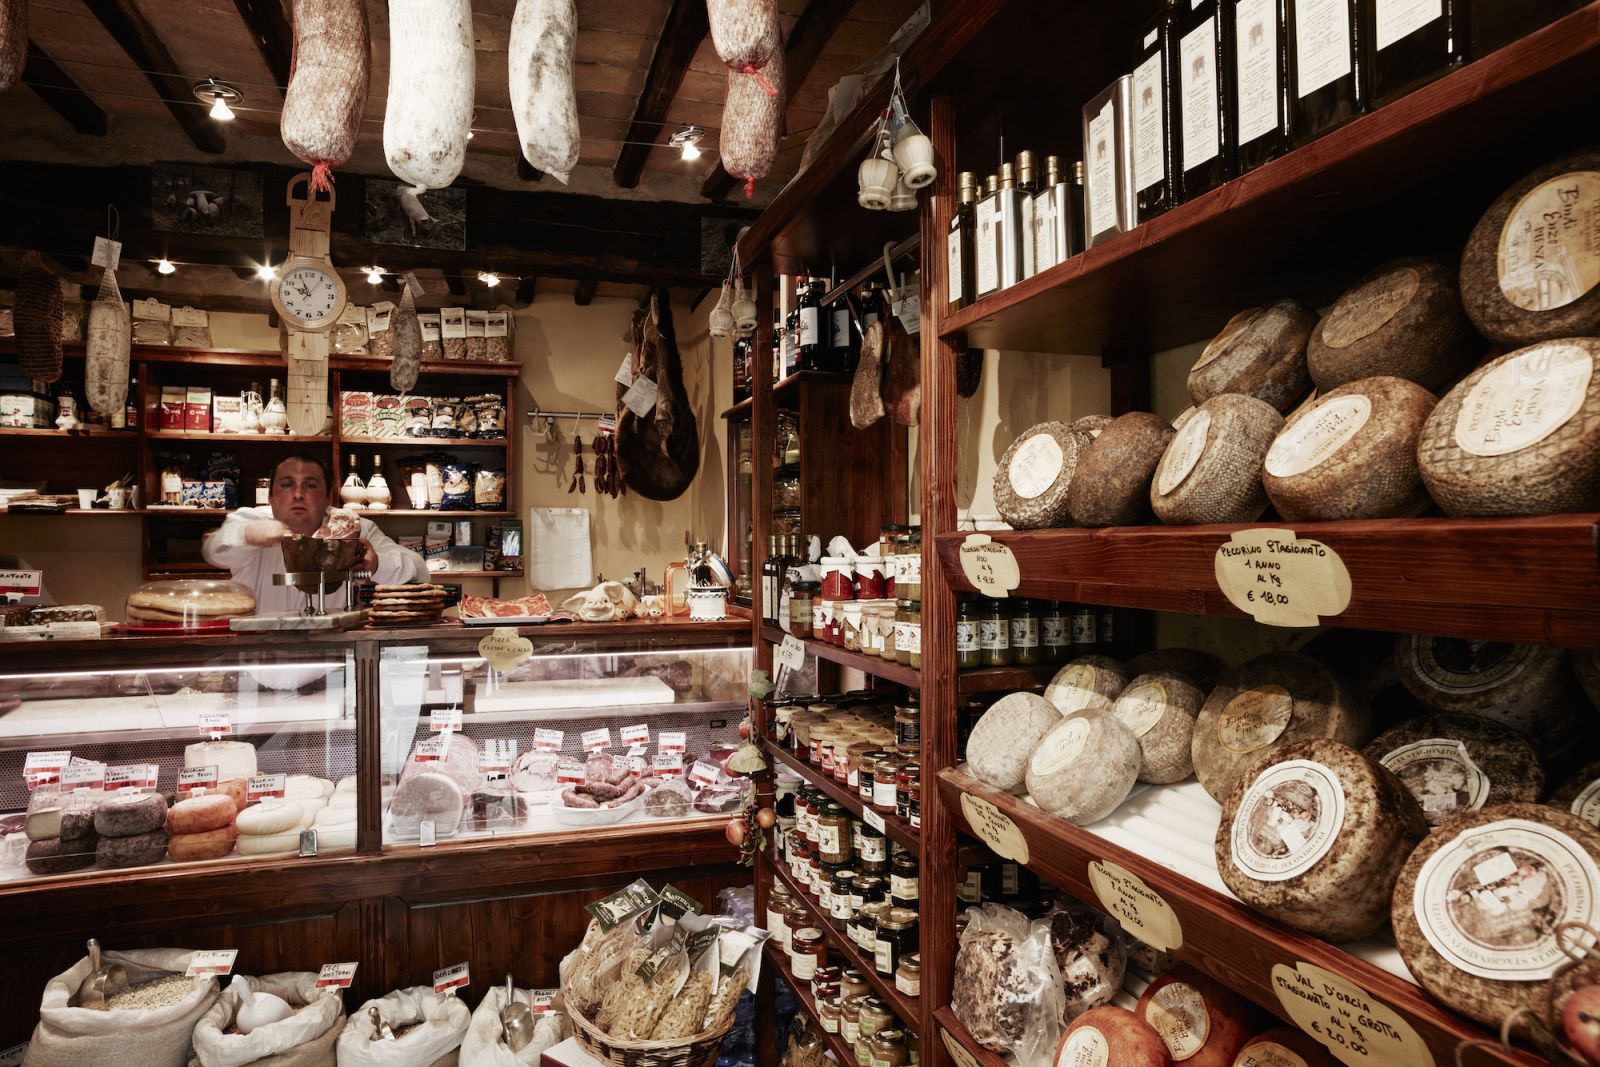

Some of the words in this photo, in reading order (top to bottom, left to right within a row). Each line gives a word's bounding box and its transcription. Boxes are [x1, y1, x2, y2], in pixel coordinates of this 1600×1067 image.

[1558, 184, 1580, 229] Bindi
[1543, 211, 1562, 244] Enzo
[1534, 227, 1545, 269] PIENZA
[1483, 410, 1506, 444] Bindi
[1220, 546, 1262, 556] PECORINO
[1266, 540, 1326, 557] STAGIONATO
[1244, 559, 1252, 568] 1
[1256, 561, 1280, 570] ANNO
[1256, 574, 1266, 582] AL
[1247, 590, 1255, 602] €
[1260, 591, 1288, 606] 18,00
[1294, 973, 1314, 988] VAL
[1323, 984, 1371, 1014] D'ORCIA
[1276, 976, 1331, 1010] STAGIONATO
[1338, 1008, 1350, 1018] IN
[1358, 1015, 1402, 1042] GROTTA
[1311, 1021, 1322, 1034] €
[1330, 1016, 1345, 1030] AL
